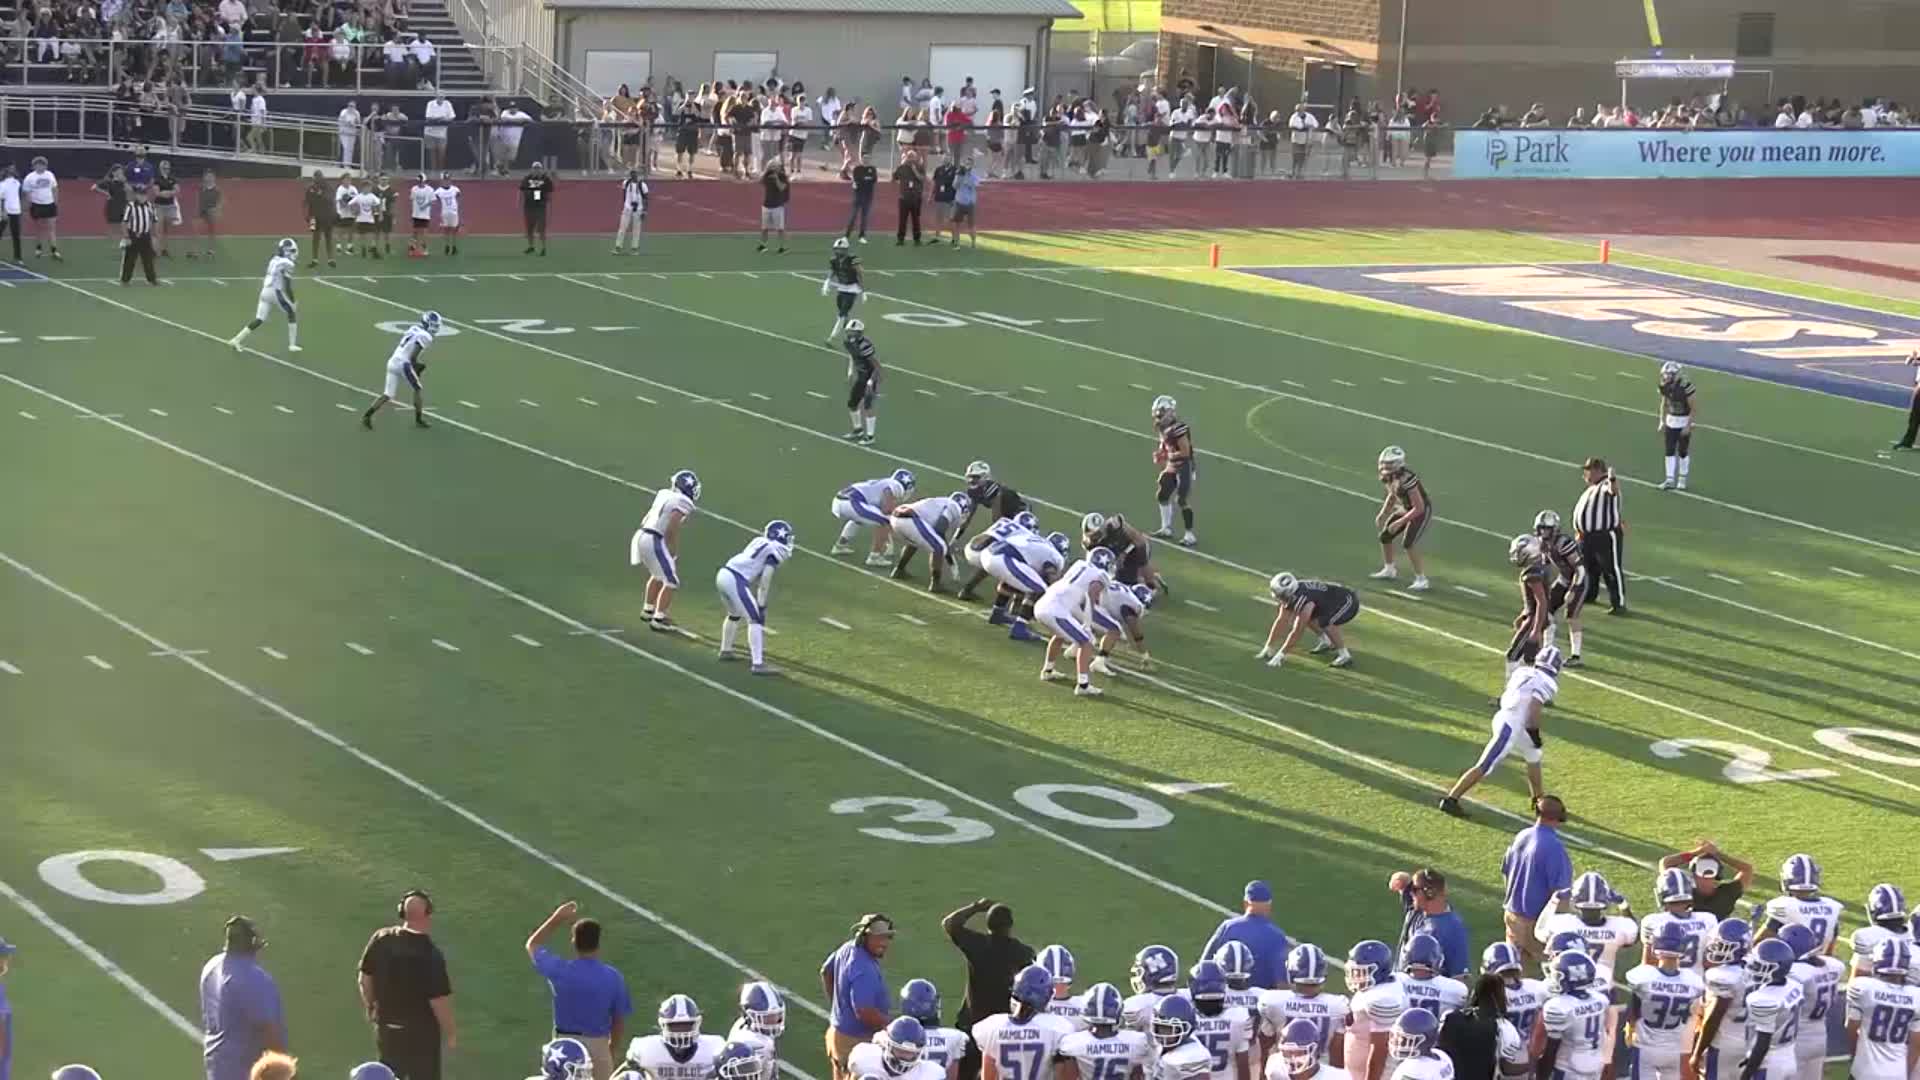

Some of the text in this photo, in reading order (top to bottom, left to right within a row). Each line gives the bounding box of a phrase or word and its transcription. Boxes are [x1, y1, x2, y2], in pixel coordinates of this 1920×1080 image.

[1514, 134, 1569, 163] Park
[1638, 139, 1886, 168] Where you mean more.
[829, 783, 1176, 844] 30
[1651, 982, 1690, 994] HAMILTON
[1874, 990, 1913, 1005] HAMILTON
[1285, 1001, 1328, 1014] HAMILTON
[1644, 995, 1693, 1030] 35
[999, 1029, 1040, 1040] HAMILTON
[1868, 1005, 1914, 1042] 88
[1000, 1043, 1045, 1080] 57
[1087, 1042, 1130, 1055] HAMILTON
